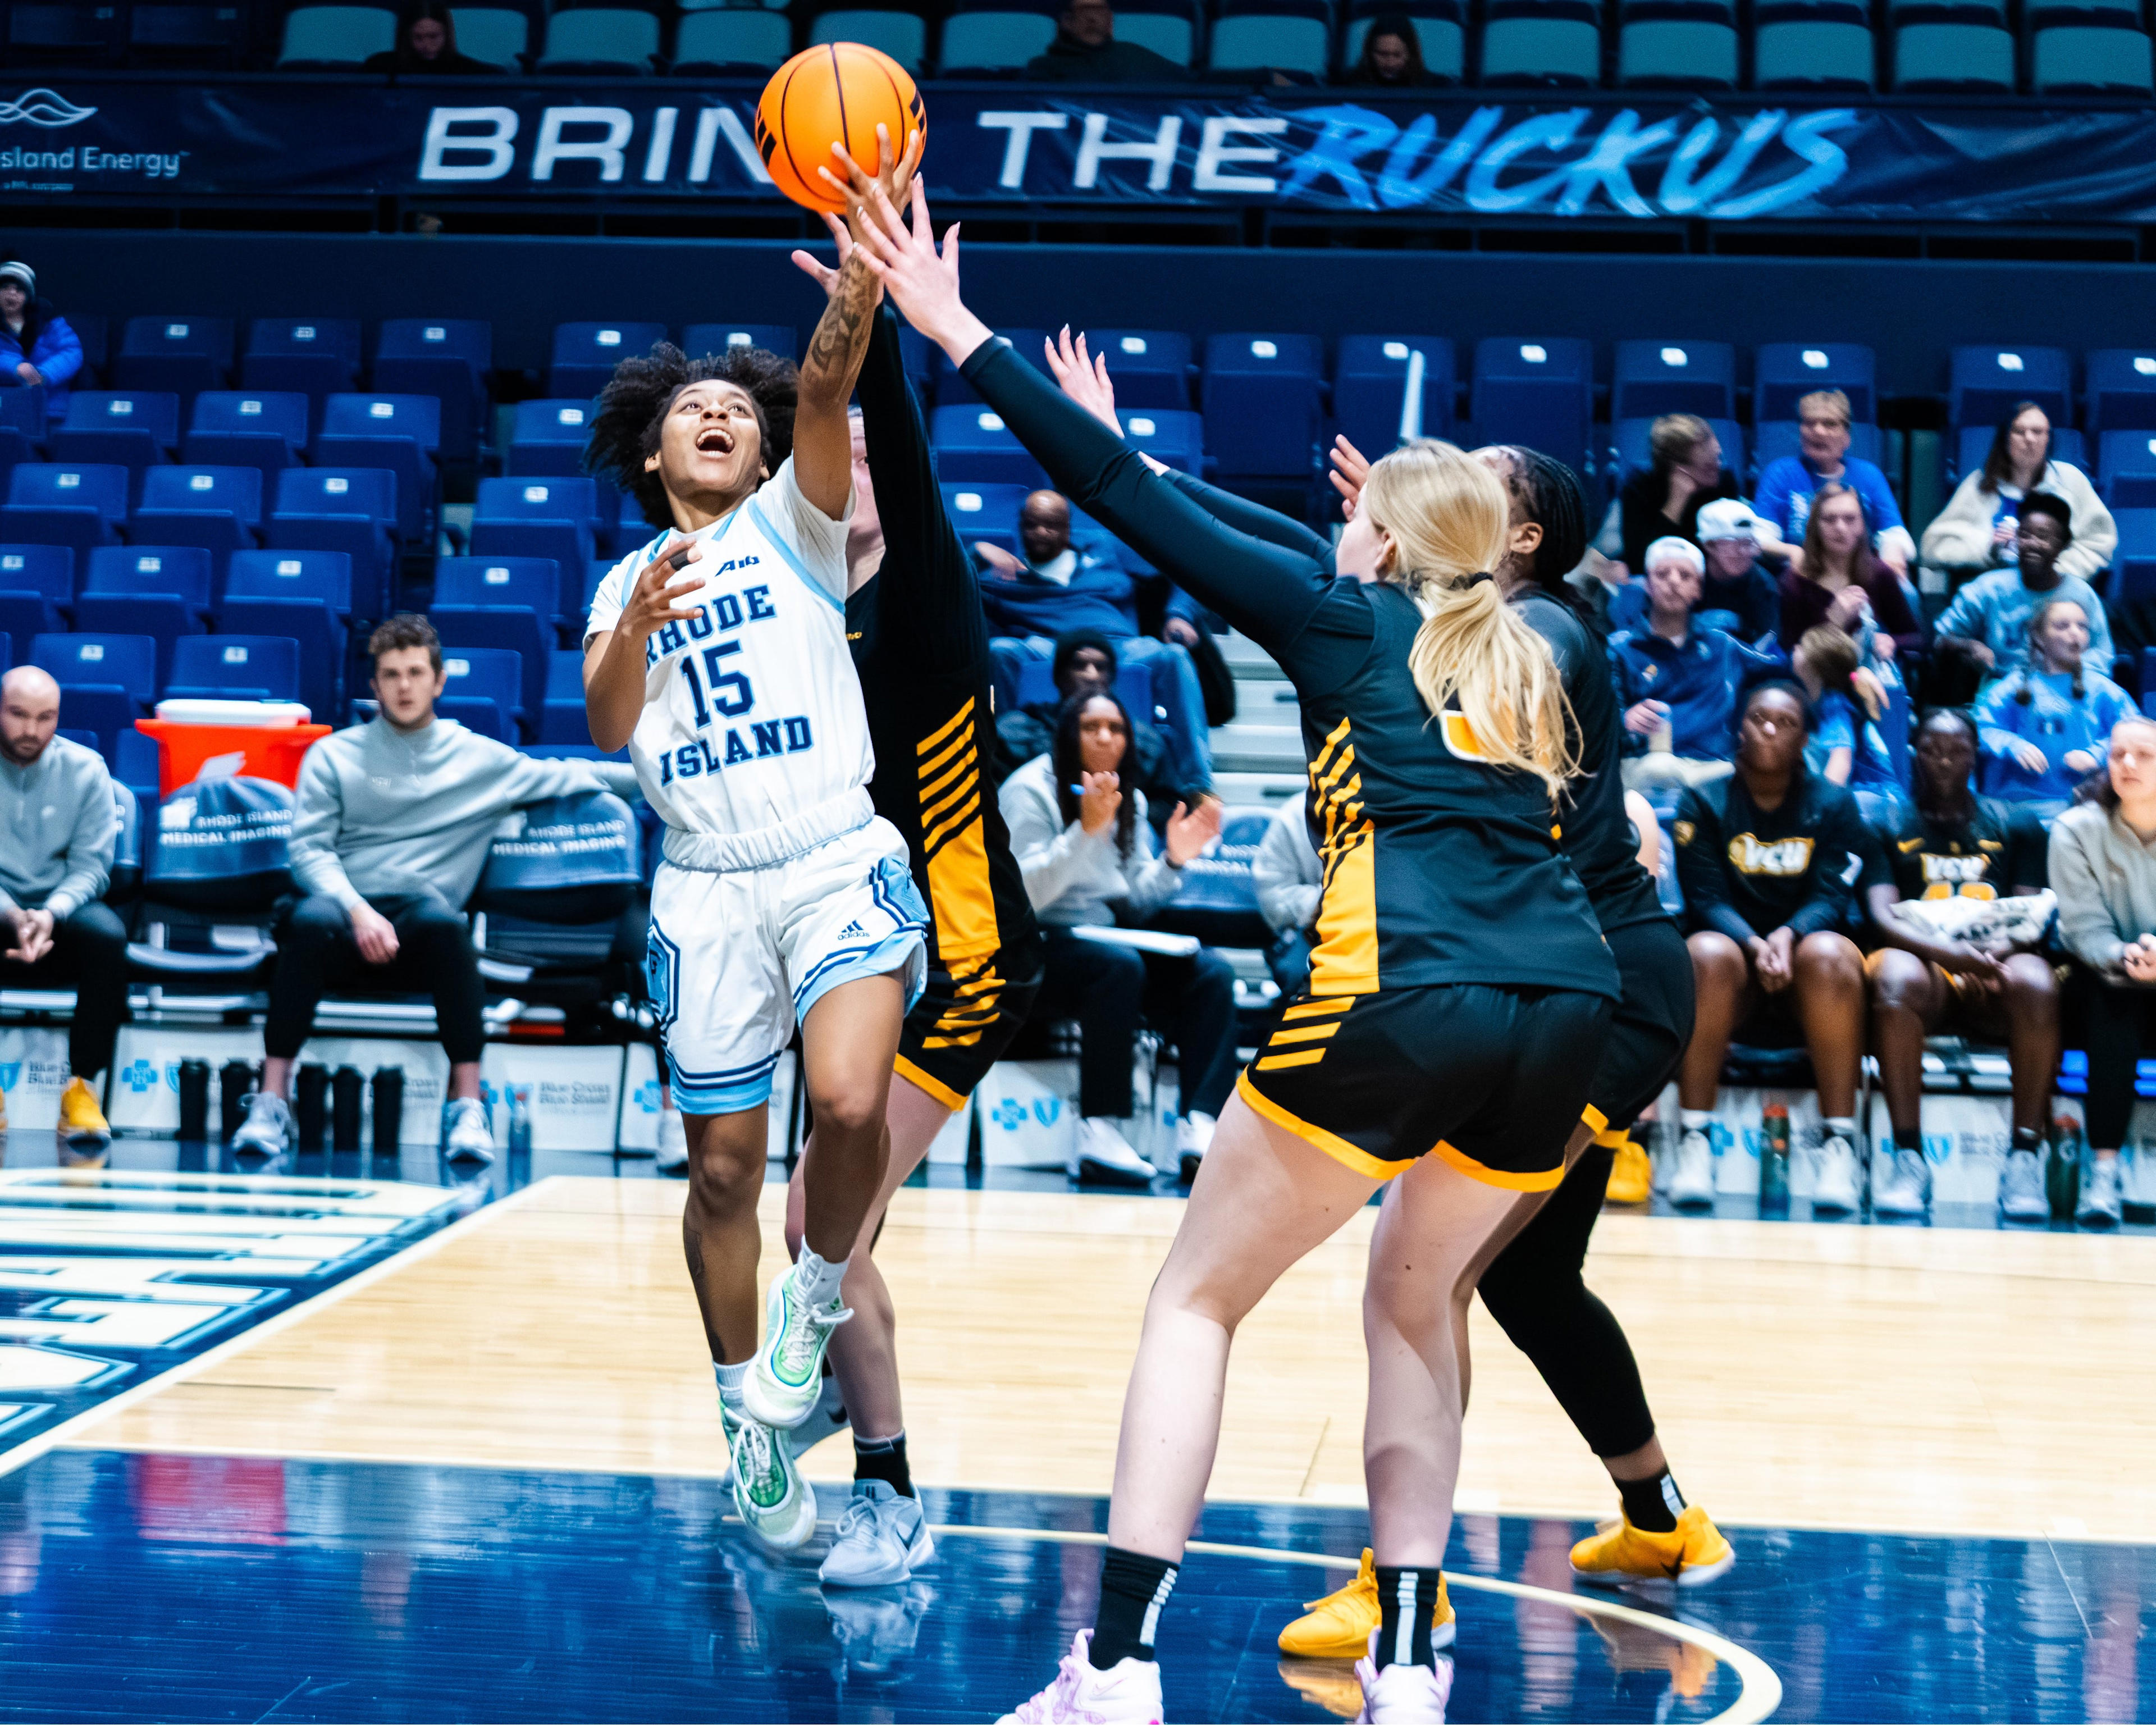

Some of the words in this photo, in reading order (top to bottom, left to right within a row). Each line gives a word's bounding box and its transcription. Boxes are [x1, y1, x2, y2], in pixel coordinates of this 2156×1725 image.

[0, 146, 75, 168] sland
[83, 146, 180, 178] Energy
[417, 107, 775, 182] BRIN
[977, 112, 1289, 192] THE
[1272, 103, 1858, 219] RUCKUS
[679, 638, 756, 731] 15
[659, 714, 815, 788] ISLAND
[159, 831, 226, 847] MEDICAL
[837, 931, 870, 941] adidas
